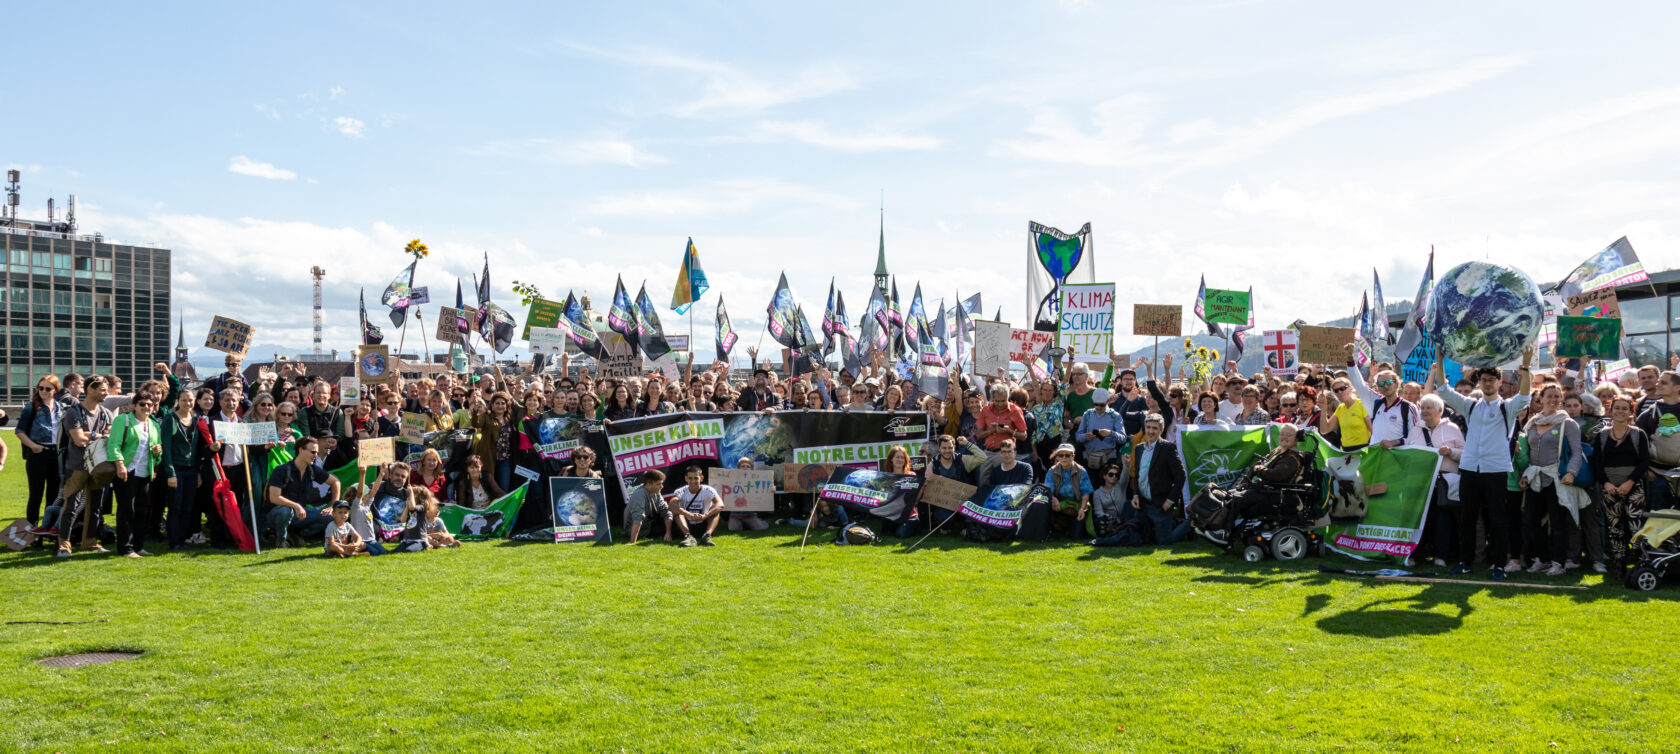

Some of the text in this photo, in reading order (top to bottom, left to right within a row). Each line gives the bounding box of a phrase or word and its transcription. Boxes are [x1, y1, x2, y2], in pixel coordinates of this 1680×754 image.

[1068, 291, 1113, 309] KLIMA
[1216, 295, 1234, 305] AGIR
[1570, 291, 1599, 309] SAUVEZ
[1061, 312, 1112, 331] SCHUTZ
[1011, 331, 1028, 341] ACT
[1030, 332, 1049, 343] NOW
[1063, 333, 1112, 355] JETZT
[1021, 342, 1033, 352] OR
[553, 440, 578, 450] KLIMA
[610, 421, 722, 453] UNSER KLIMA
[616, 442, 714, 474] DEINE WAHL
[796, 447, 855, 464] NOTRE
[825, 491, 879, 506] DEINE WAHL
[828, 484, 886, 499] UNSER KLIMA
[961, 507, 1013, 527] DEINE WAHL
[966, 501, 995, 517] UNSER
